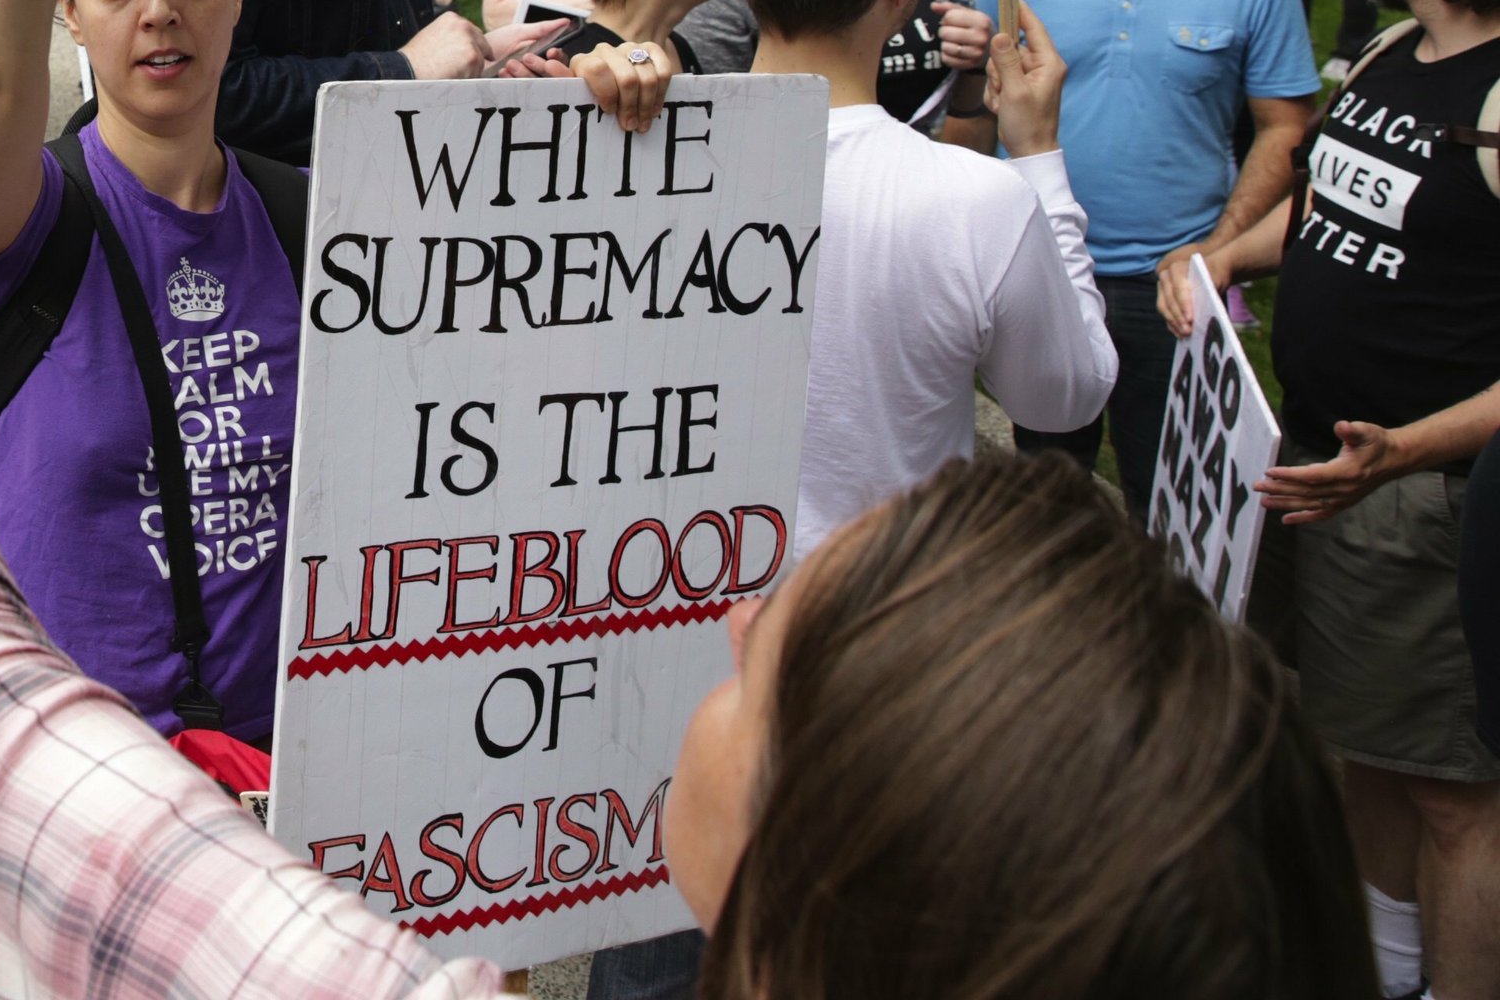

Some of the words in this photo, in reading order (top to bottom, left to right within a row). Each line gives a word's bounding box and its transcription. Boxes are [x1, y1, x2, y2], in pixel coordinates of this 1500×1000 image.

[395, 100, 713, 212] WHITE
[1317, 151, 1393, 209] IVES
[310, 222, 821, 335] SUPREMACY
[1299, 211, 1406, 280] TTER
[161, 330, 260, 373] KEEP
[174, 362, 274, 410] ALM
[1203, 316, 1241, 432] GO
[178, 405, 247, 443] OR
[404, 401, 498, 499] IS
[539, 384, 719, 488] THE
[1173, 348, 1249, 542] AWAY
[137, 469, 213, 496] UE
[228, 463, 291, 493] MY
[299, 504, 786, 651] LIFEBLOOD
[474, 656, 598, 759] OF
[308, 777, 673, 914] FASCISM
